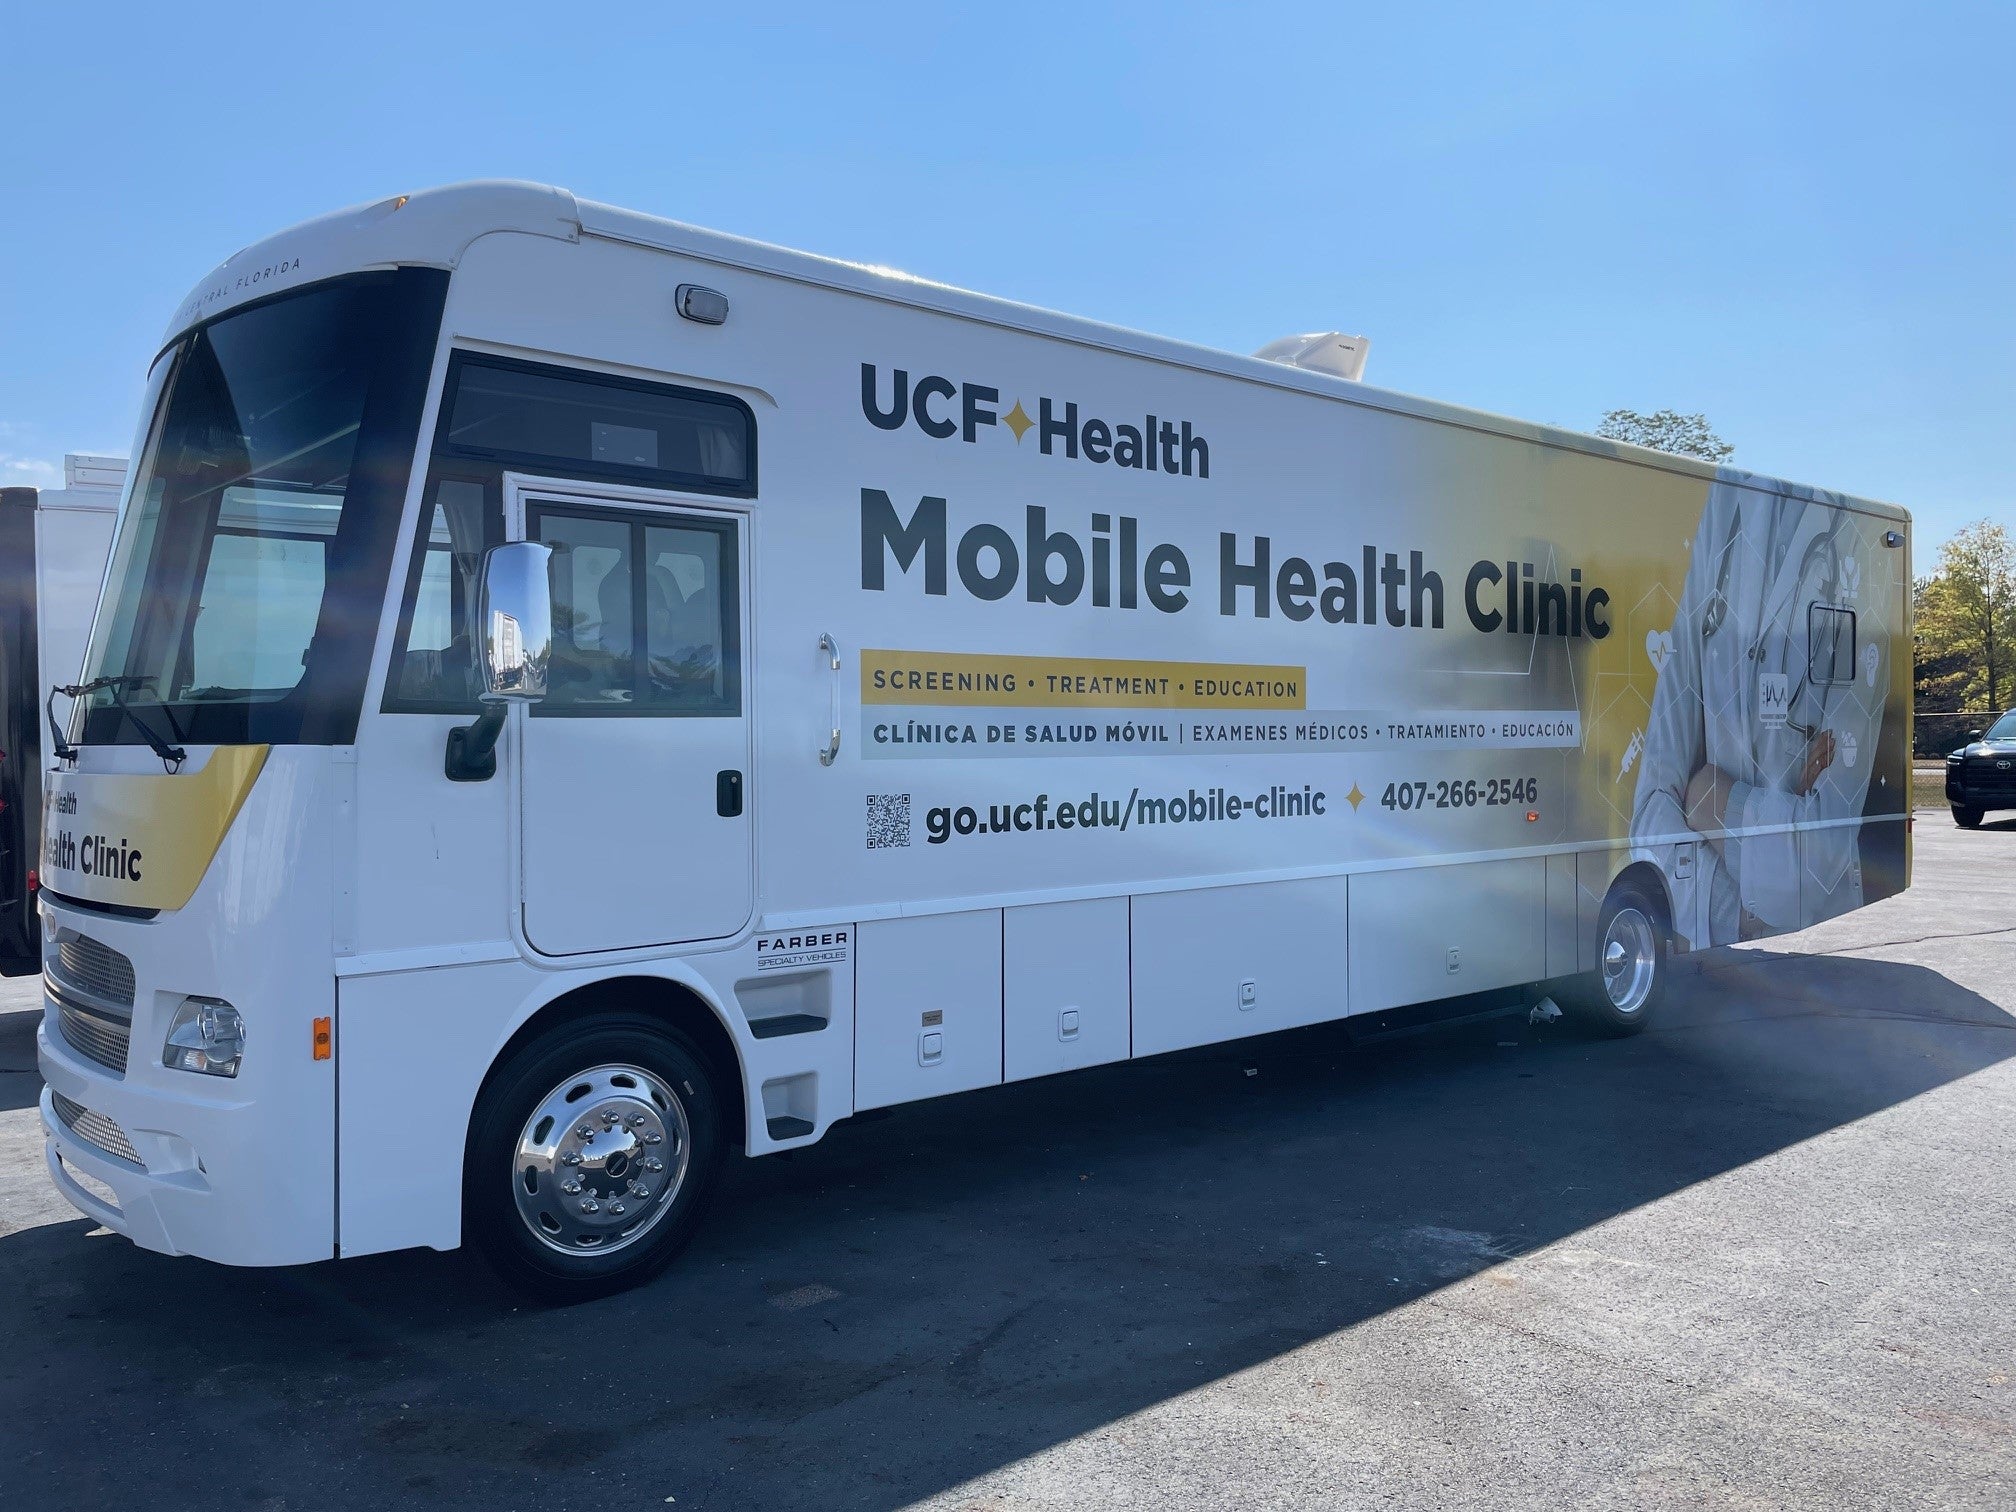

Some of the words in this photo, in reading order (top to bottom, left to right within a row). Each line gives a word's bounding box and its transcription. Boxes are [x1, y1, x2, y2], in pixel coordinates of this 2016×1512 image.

[236, 258, 300, 290] FLORIDA
[861, 362, 999, 443] UCF
[1039, 397, 1209, 479] Health
[861, 487, 1191, 614] Mobile
[1220, 532, 1444, 629] Health
[1465, 560, 1611, 640] Clinic
[873, 669, 1016, 692] SCREENING
[1047, 675, 1169, 695] TREATMENT
[1194, 679, 1297, 697] EDUCATION
[873, 719, 977, 743] CLÍNICA
[987, 725, 1015, 743] DE
[1025, 725, 1097, 742] SALUD
[1105, 721, 1168, 742] MÓVIL
[1193, 725, 1287, 741] EXAMENES
[1296, 722, 1368, 740] MÉDICOS
[1388, 724, 1485, 739] TRATAMIENTO
[1502, 721, 1573, 738] EDUCACIÓN
[926, 785, 1326, 844] go.ucf.edu/mobile-clinic
[1381, 777, 1538, 811] 407-266-2546
[81, 835, 142, 881] Clinic
[757, 932, 847, 951] FARBER
[757, 955, 804, 967] SPECIALTY
[807, 951, 846, 963] VEHICLES
